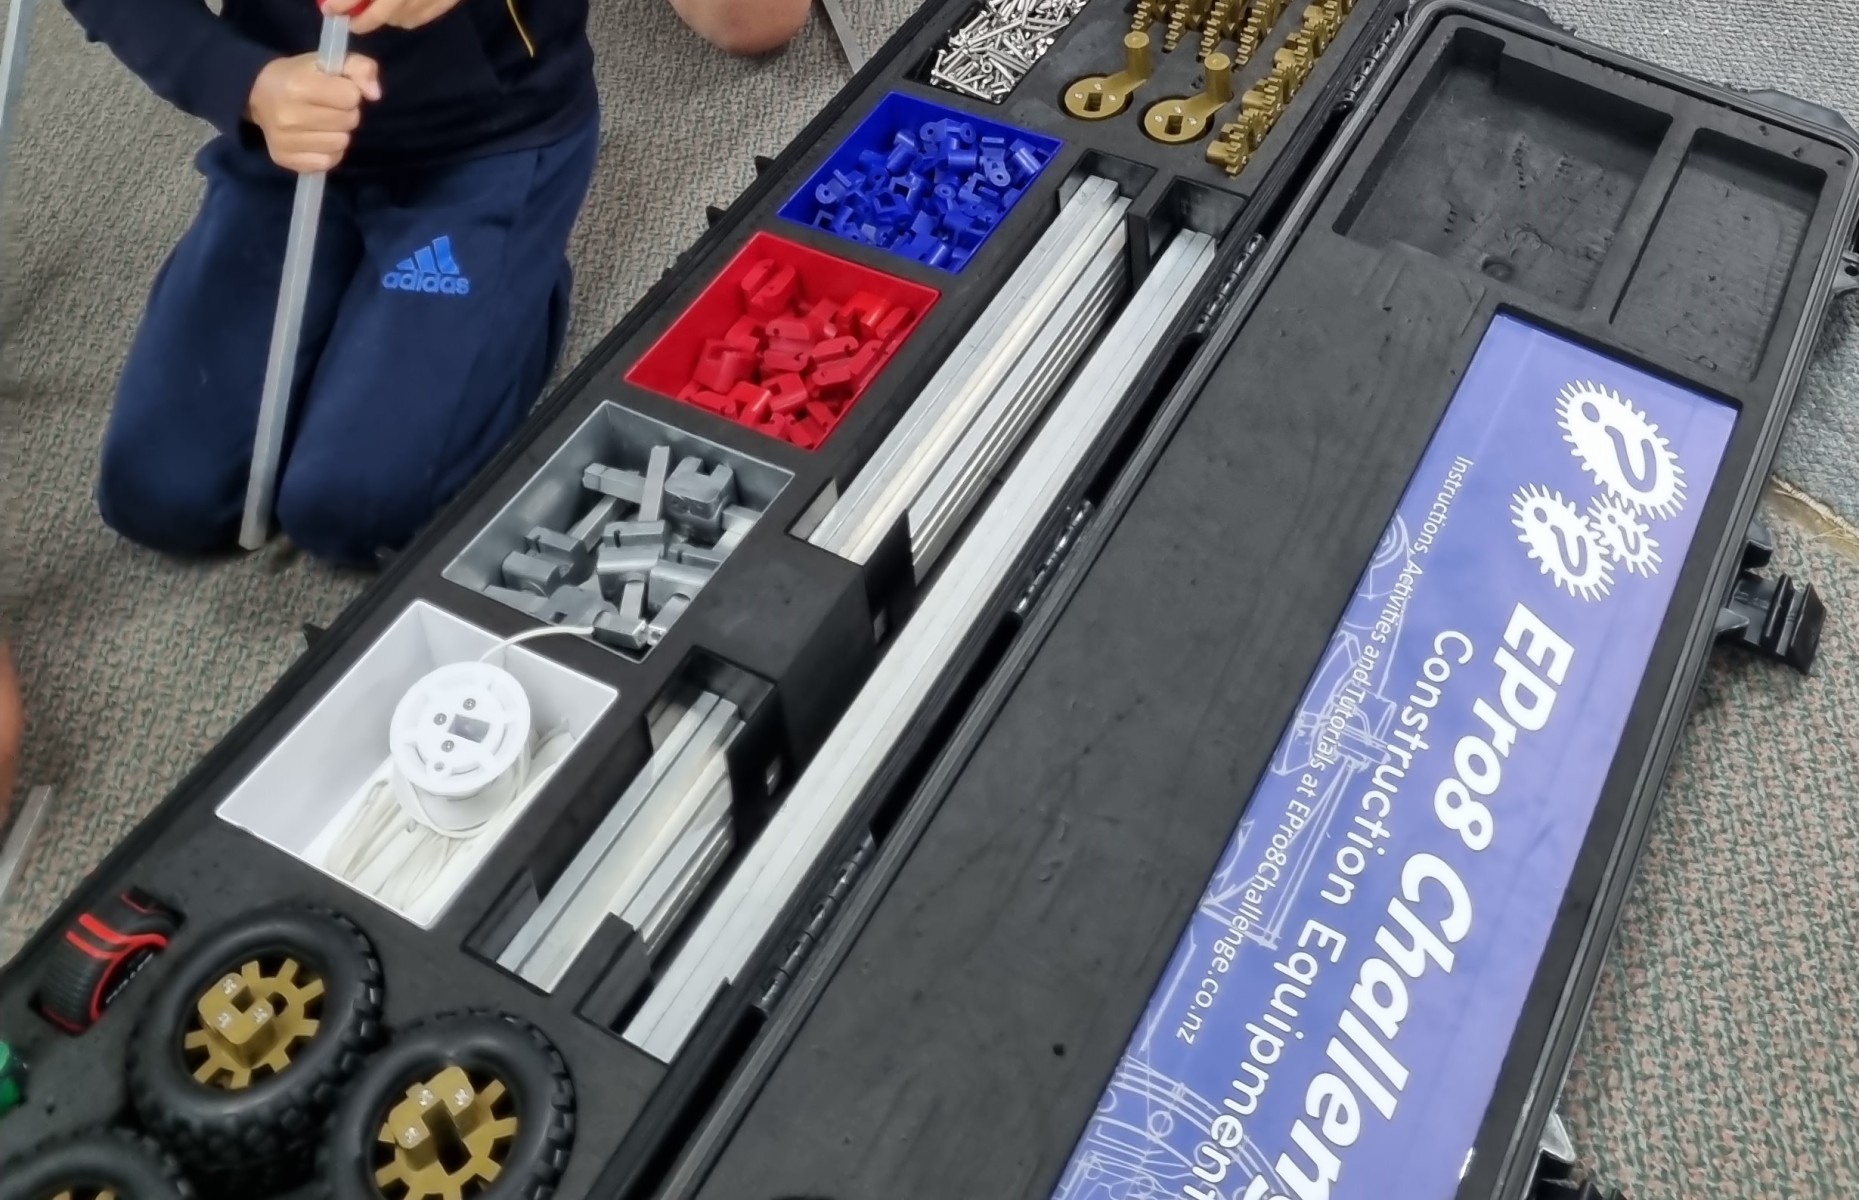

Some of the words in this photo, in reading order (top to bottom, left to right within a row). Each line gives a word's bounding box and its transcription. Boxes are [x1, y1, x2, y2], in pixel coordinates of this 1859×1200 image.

[382, 268, 470, 295] adidas
[1408, 455, 1475, 556] Instructions,
[1371, 558, 1423, 644] Activities
[1350, 645, 1380, 690] and
[1310, 687, 1366, 771] Tutorials
[1320, 629, 1473, 905] Construction
[1433, 602, 1576, 851] EPro8
[1295, 772, 1319, 799] at
[1176, 798, 1312, 1044] EPro8Challenge.co.nz
[1243, 852, 1473, 1200] Challen
